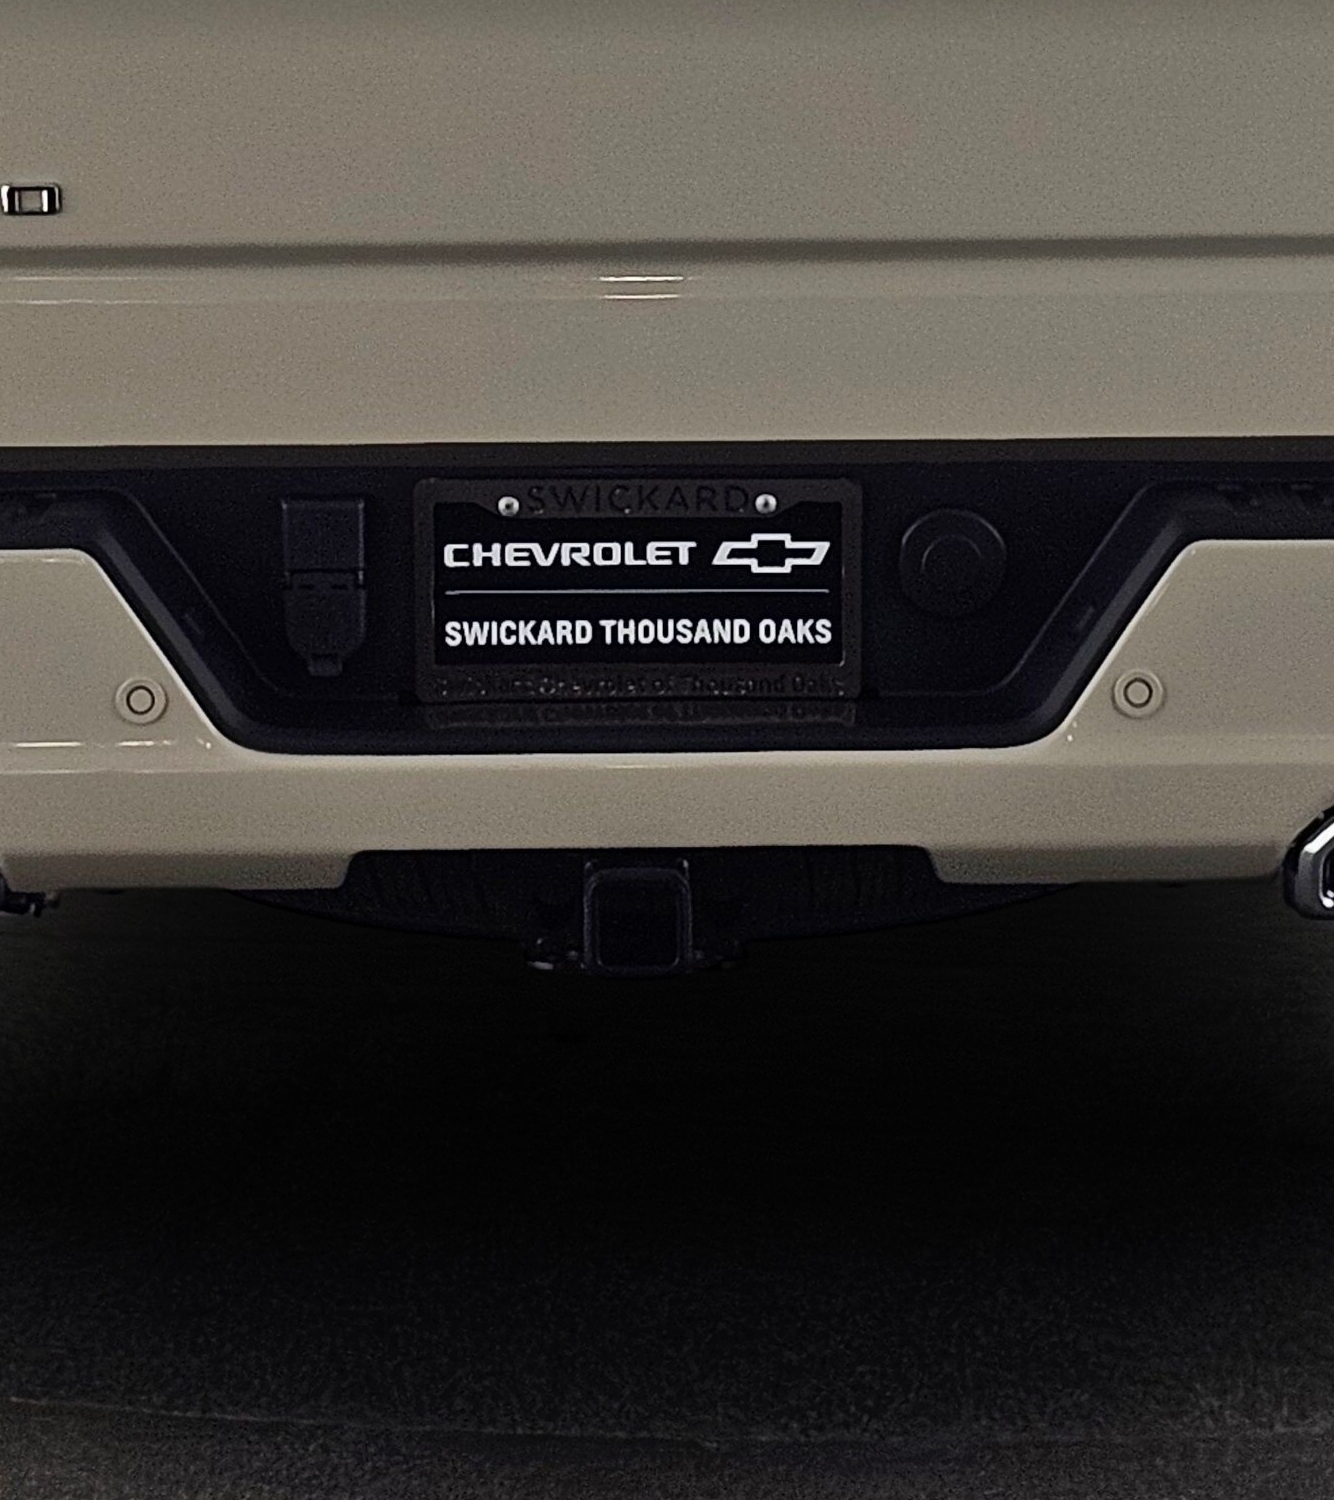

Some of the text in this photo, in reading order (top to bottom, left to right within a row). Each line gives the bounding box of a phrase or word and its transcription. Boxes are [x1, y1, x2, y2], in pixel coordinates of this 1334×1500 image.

[526, 485, 750, 513] SWICKARD
[443, 541, 697, 567] CHEVROLET
[444, 617, 833, 647] SWICKARD THOUSAND OAKS
